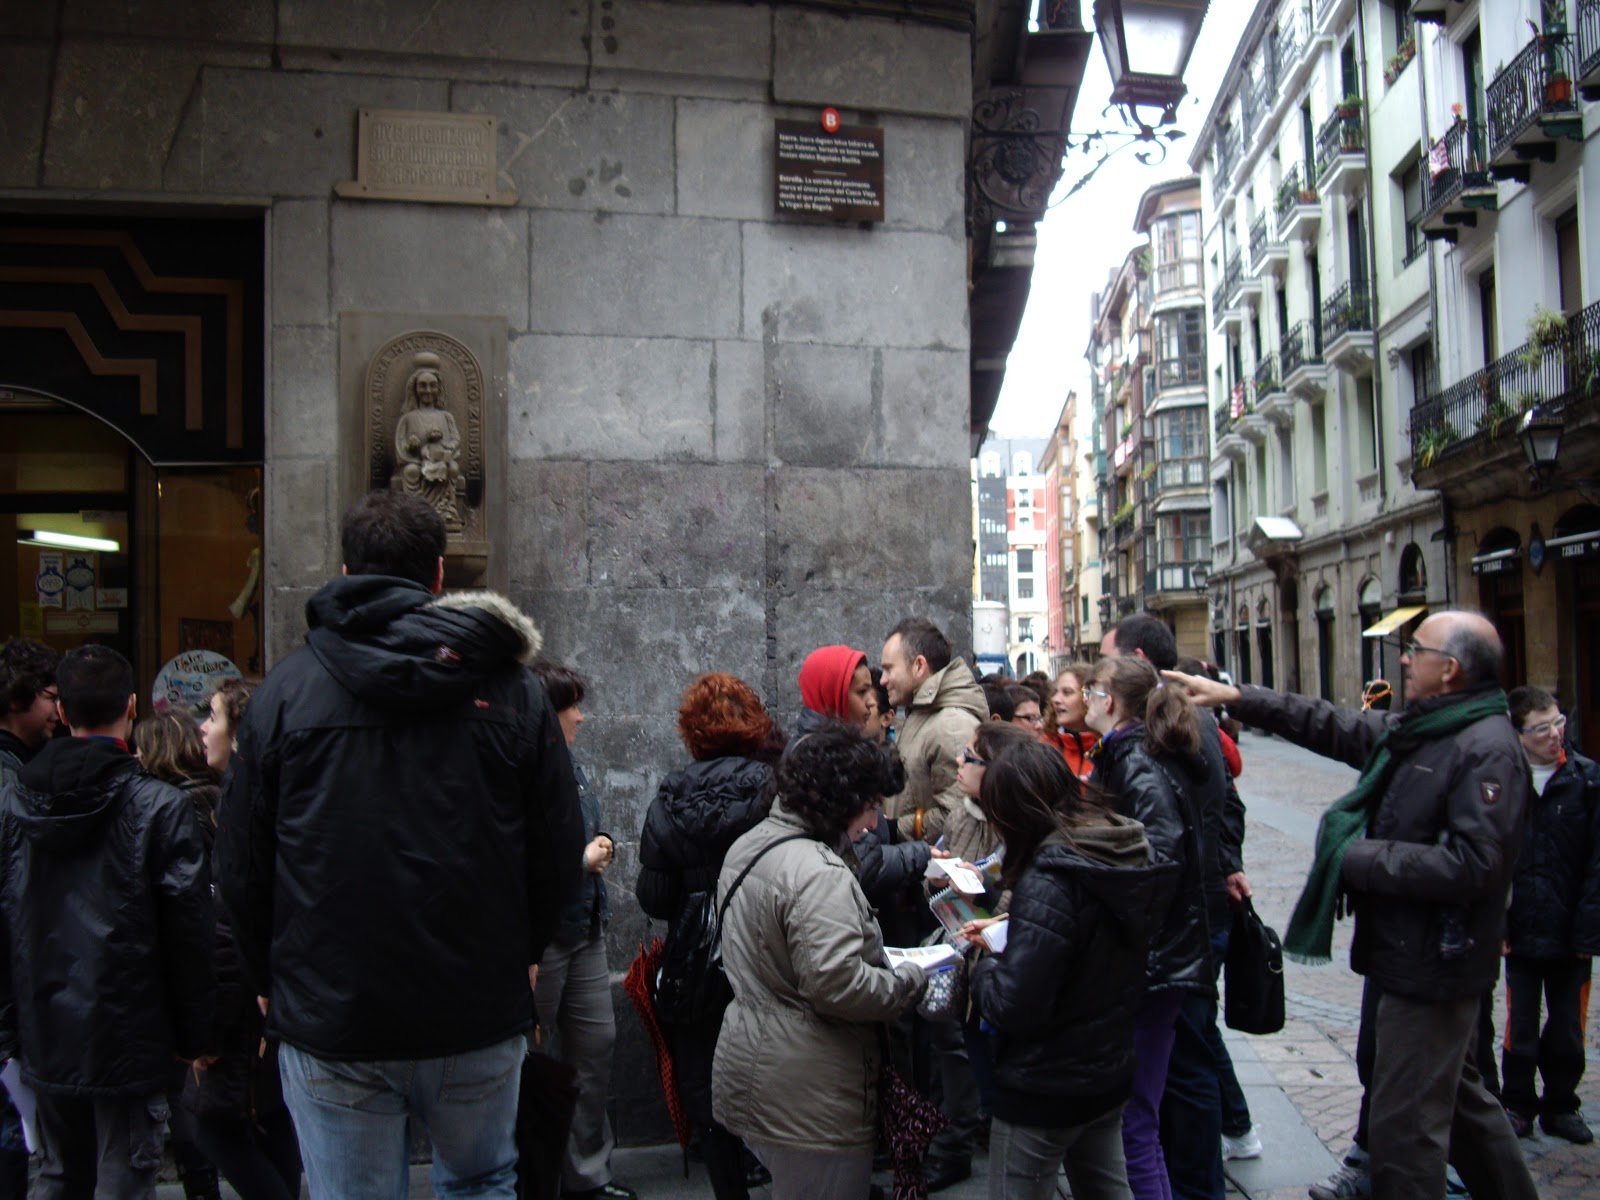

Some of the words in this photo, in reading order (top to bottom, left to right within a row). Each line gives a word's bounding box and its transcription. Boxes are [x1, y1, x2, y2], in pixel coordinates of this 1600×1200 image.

[825, 113, 836, 127] B
[812, 177, 833, 186] estrella
[833, 178, 842, 186] del
[779, 184, 797, 192] marca
[835, 187, 845, 195] del
[845, 188, 862, 197] Casco
[779, 192, 796, 200] desde
[802, 194, 813, 202] que
[814, 194, 831, 203] puede
